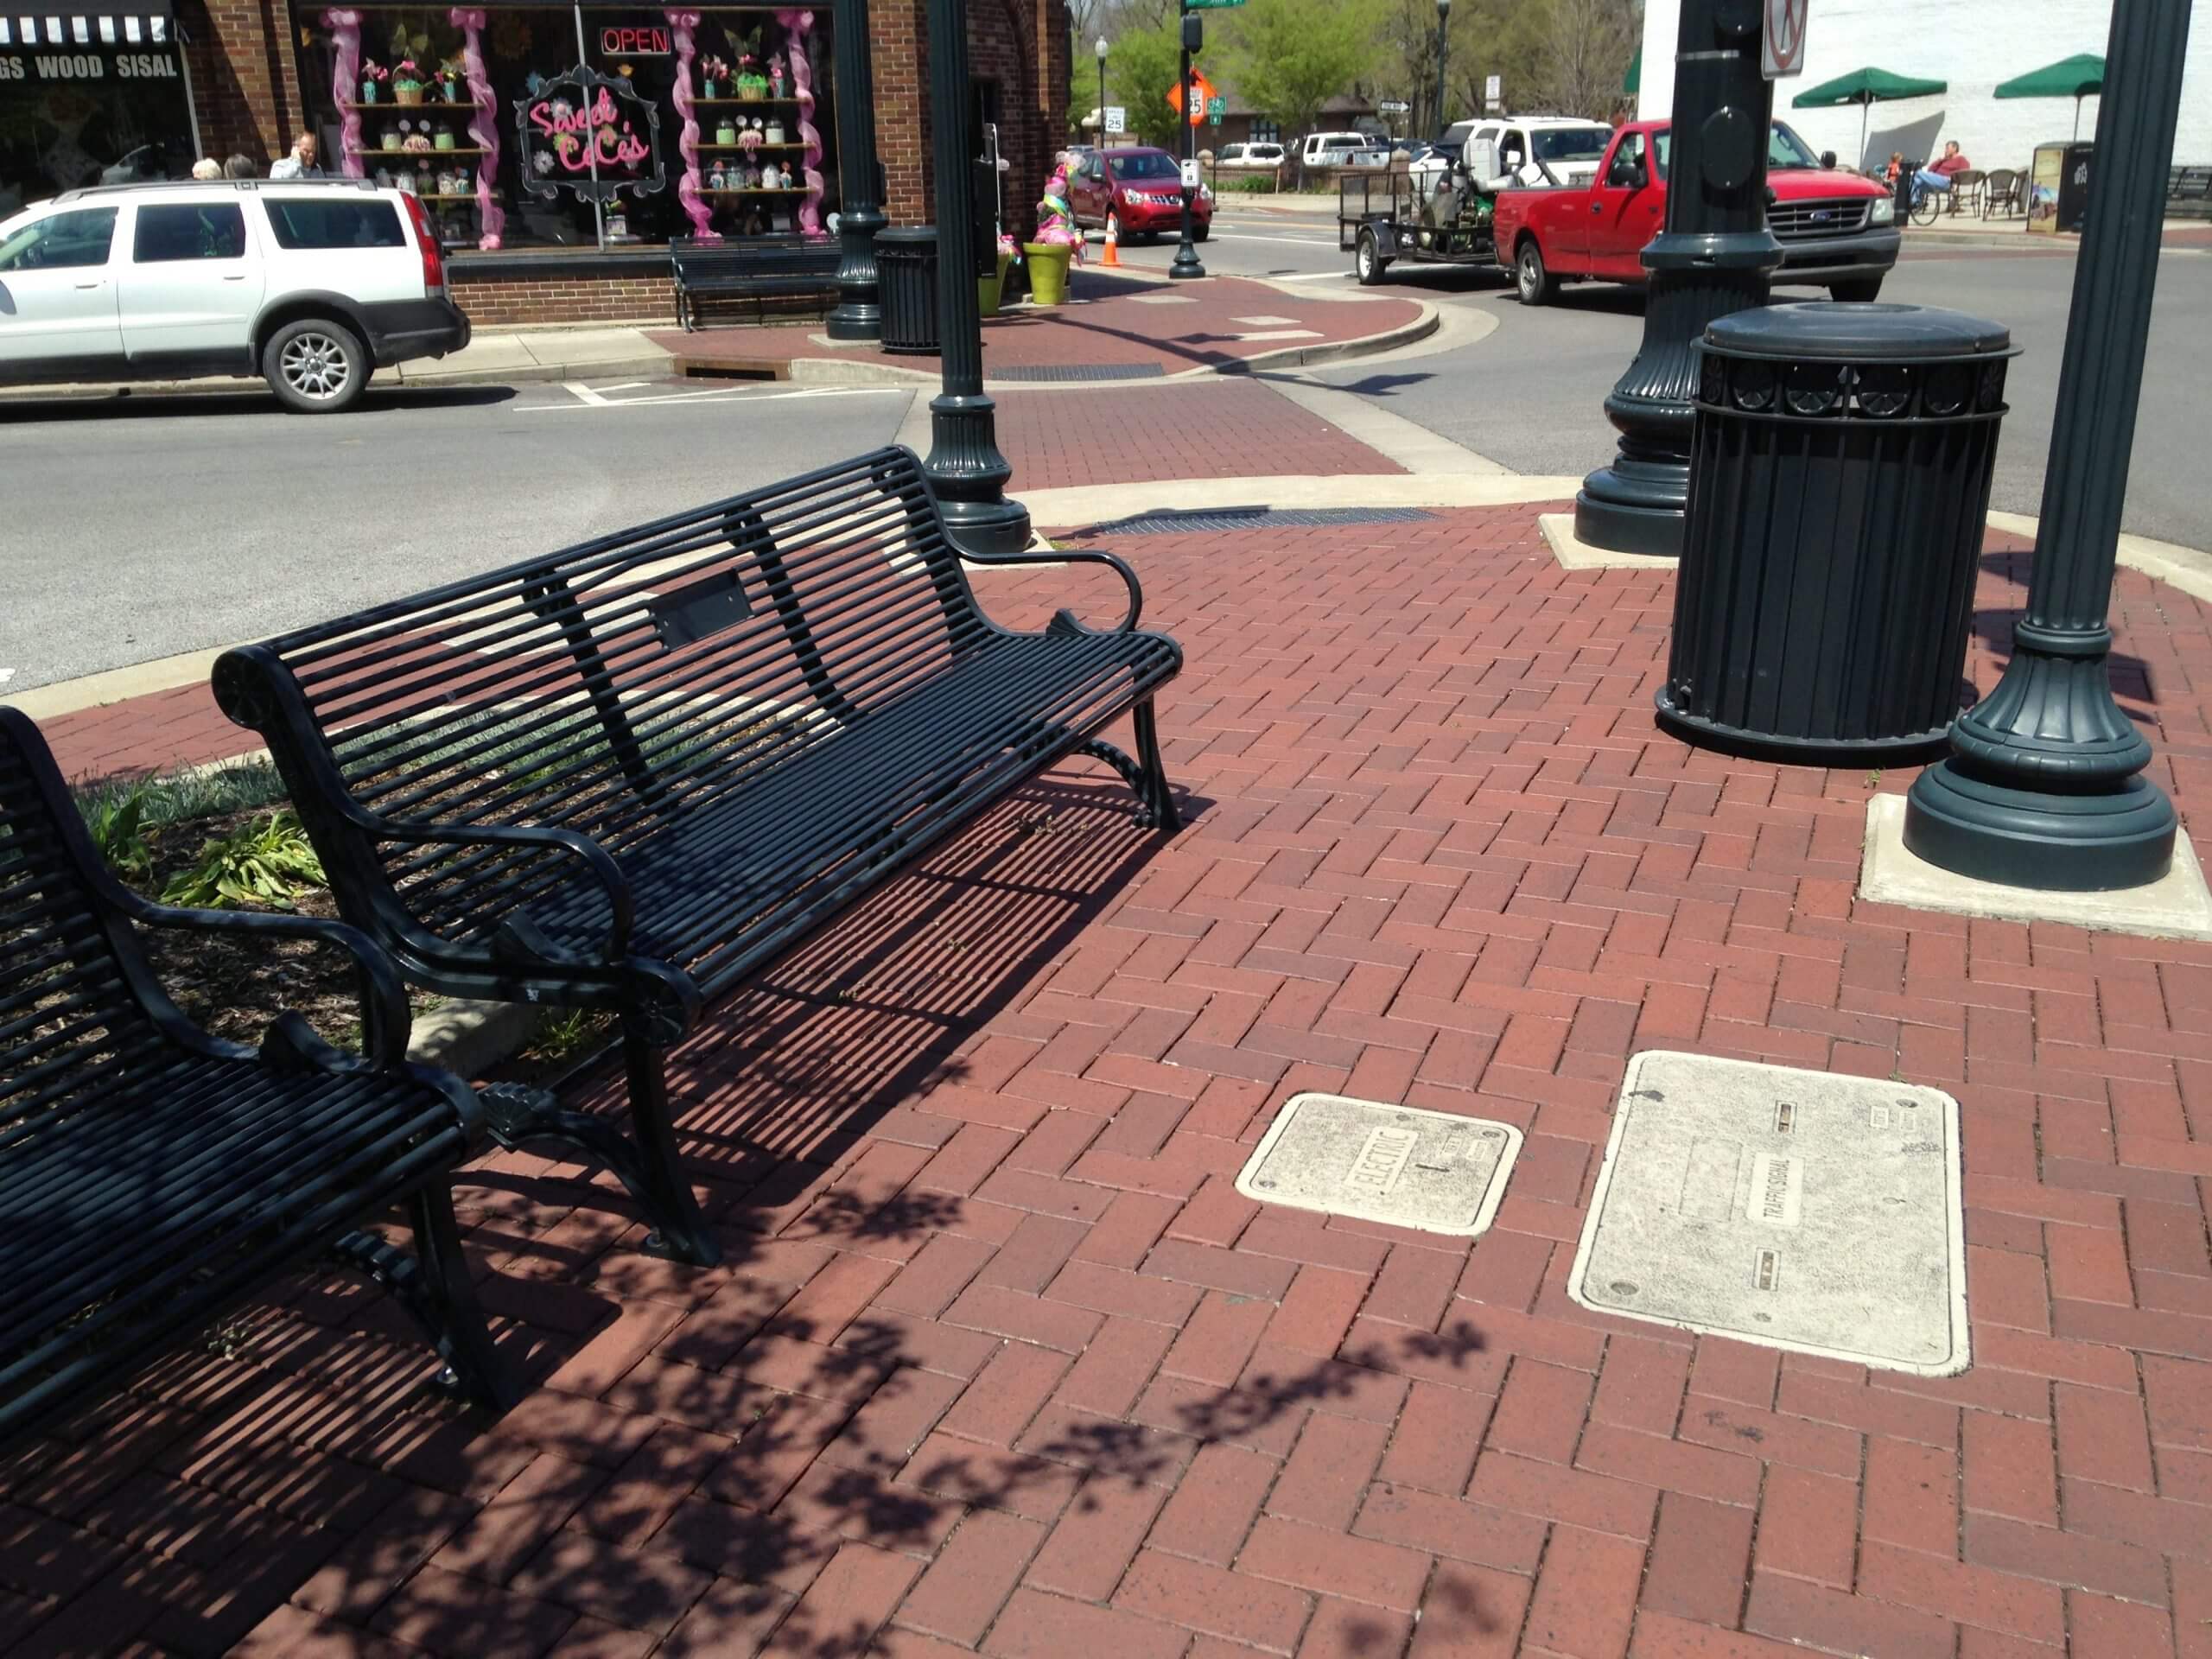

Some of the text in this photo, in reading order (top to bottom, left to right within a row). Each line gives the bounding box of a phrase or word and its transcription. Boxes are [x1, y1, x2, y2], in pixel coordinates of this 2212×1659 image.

[603, 28, 668, 54] OPEN
[0, 54, 177, 79] GS WOOD SISAL
[530, 86, 618, 138] Sweet
[1108, 118, 1122, 130] 25
[1354, 1130, 1410, 1186] ELECTRIC
[1763, 1159, 1790, 1219] TRAFFIC SIGNAL
